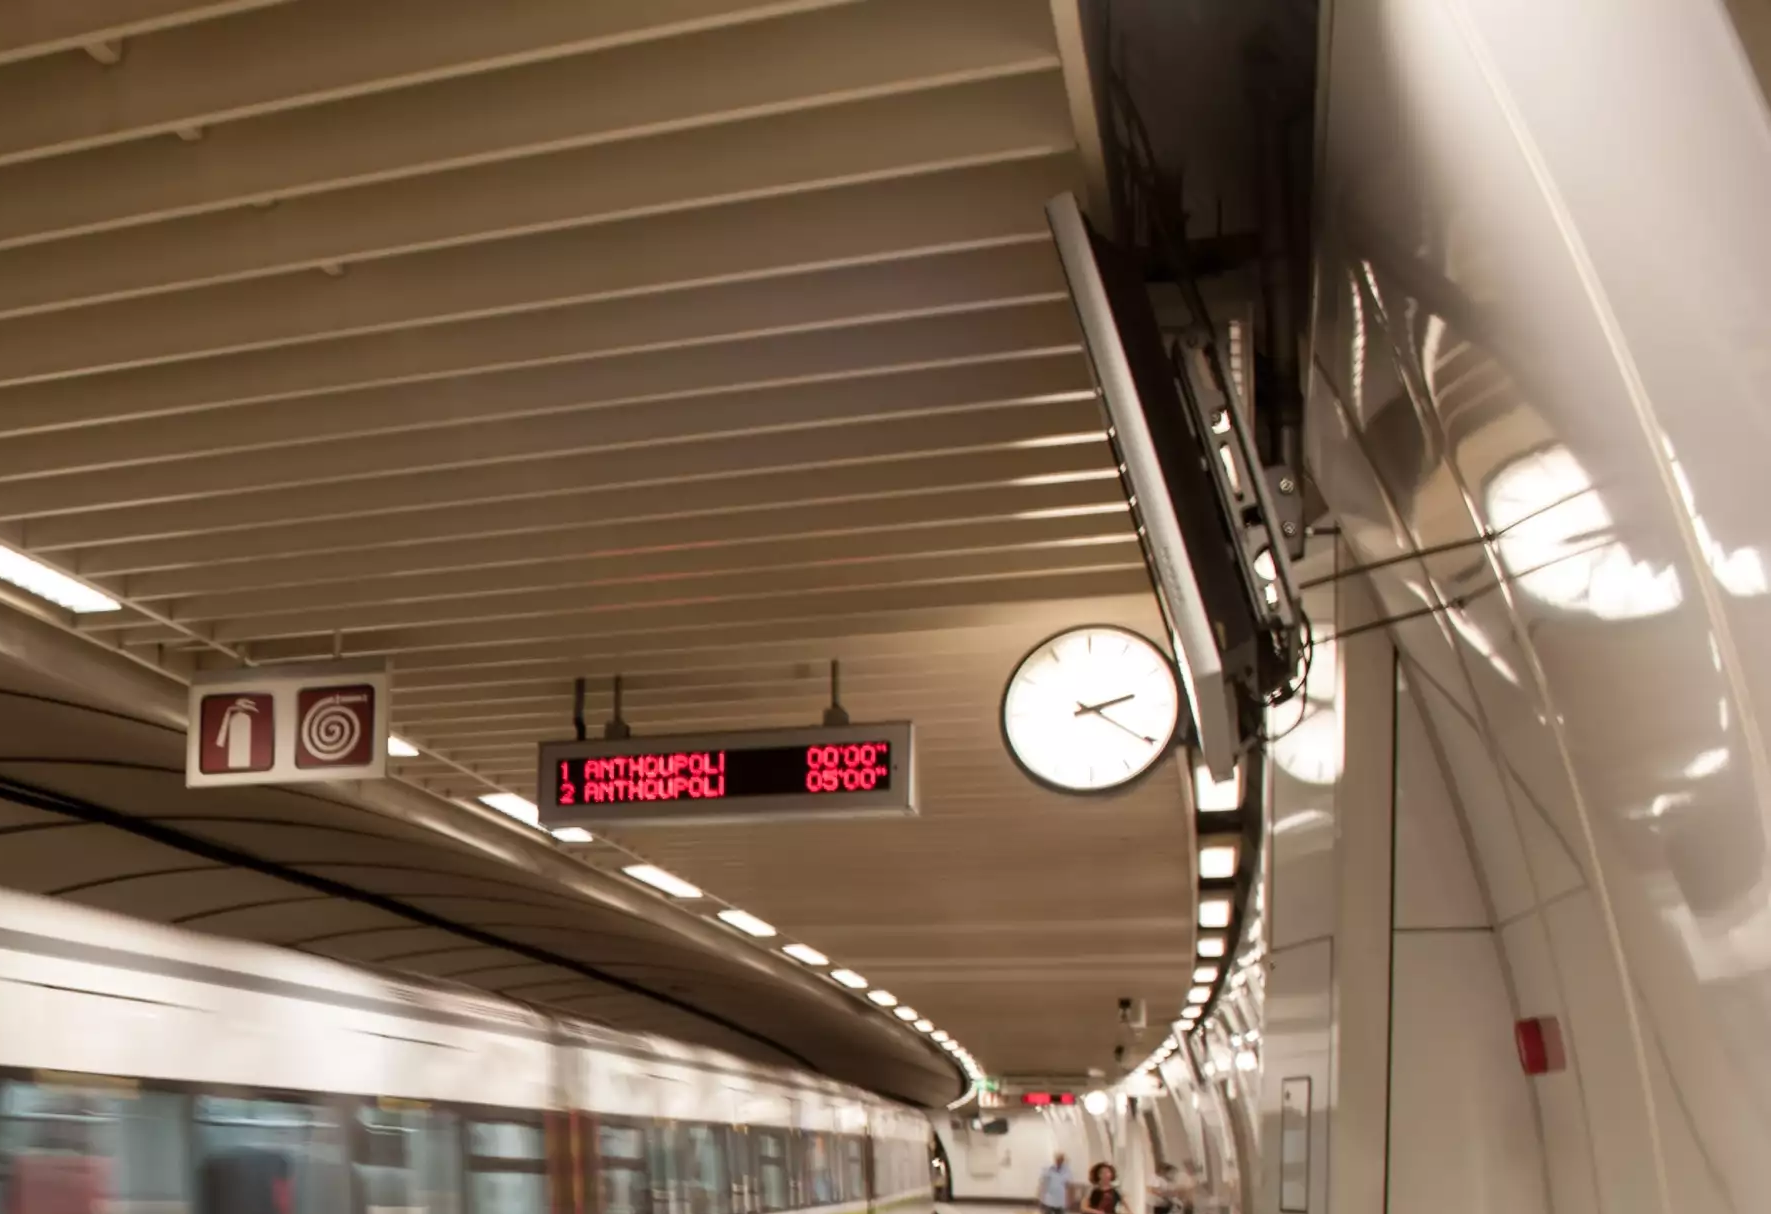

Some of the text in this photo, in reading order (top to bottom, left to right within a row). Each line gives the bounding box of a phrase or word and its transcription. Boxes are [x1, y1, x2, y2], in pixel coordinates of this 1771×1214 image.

[560, 761, 569, 781] 1
[584, 752, 725, 781] ANTHOUPOLI
[559, 782, 575, 804] 2
[584, 775, 725, 803] ANTHOUPOLI
